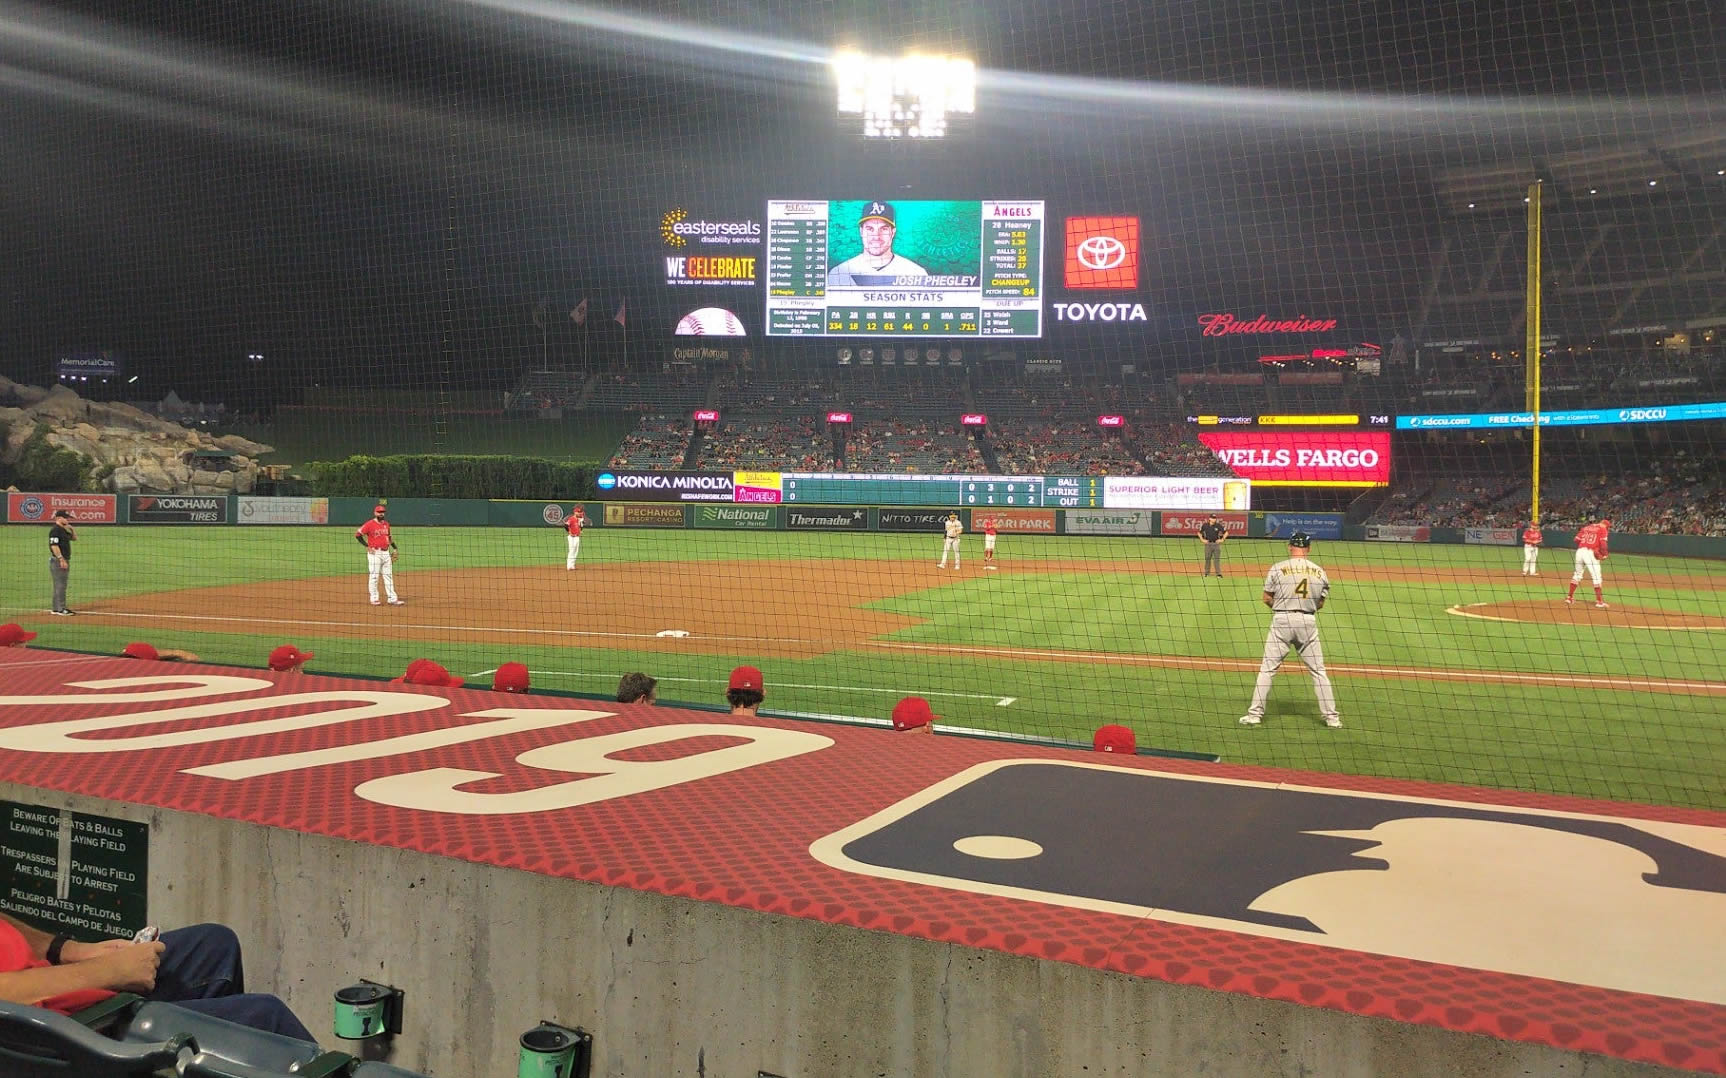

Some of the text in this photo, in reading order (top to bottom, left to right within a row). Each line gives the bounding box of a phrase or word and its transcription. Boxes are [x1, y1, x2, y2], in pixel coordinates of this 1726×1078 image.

[994, 206, 1032, 216] ANGELS
[674, 220, 760, 234] easterseals
[701, 236, 730, 244] disability
[666, 256, 755, 278] WE CELEBRATE
[893, 276, 977, 286] JOSH PHEGLEY
[1023, 288, 1036, 296] 84
[864, 294, 944, 302] SEASON STATS
[1054, 303, 1147, 320] TOYOTA
[828, 322, 842, 330] 334
[958, 323, 976, 331] .711
[1198, 314, 1337, 336] Budweiser
[61, 358, 115, 368] MemorialCare
[1370, 416, 1388, 424] 7:41
[1631, 409, 1667, 420] SDCCU
[1422, 417, 1470, 426] sdccu.com
[1296, 450, 1379, 468] FARGO
[618, 476, 732, 490] KONICA MINOLTA
[738, 488, 776, 502] ANGELS
[1048, 488, 1079, 496] STRIKE
[1110, 486, 1157, 494] SUPERIOR
[52, 496, 105, 506] Insurance
[157, 499, 218, 510] YOKOHAMA
[968, 496, 974, 504] 0
[1028, 496, 1034, 504] 2
[190, 512, 218, 521] TIRES
[628, 508, 682, 517] PECHANGA
[718, 508, 769, 520] National
[790, 514, 852, 526] Thermador
[882, 514, 911, 523] NITTO
[1020, 518, 1050, 528] PARK
[1102, 516, 1124, 524] AIR
[1281, 566, 1322, 579] WILLIAMS
[1295, 578, 1308, 598] 4
[0, 675, 835, 814] 2019
[14, 808, 48, 823] BEWARE
[86, 822, 93, 832] &
[96, 824, 123, 837] BALLS
[10, 821, 44, 836] LEAVING
[45, 830, 60, 840] THE
[100, 838, 126, 852] FIELD
[1, 845, 136, 882] TRESPASSERS PLAYING FIELD
[16, 863, 32, 875] ARE
[72, 876, 82, 884] TO
[84, 877, 118, 892] ARREST
[12, 888, 121, 921] PELIGRO BATES Y PELOTAS
[0, 899, 133, 938] SALIENDO DEL CAMPO DE JUEGO
